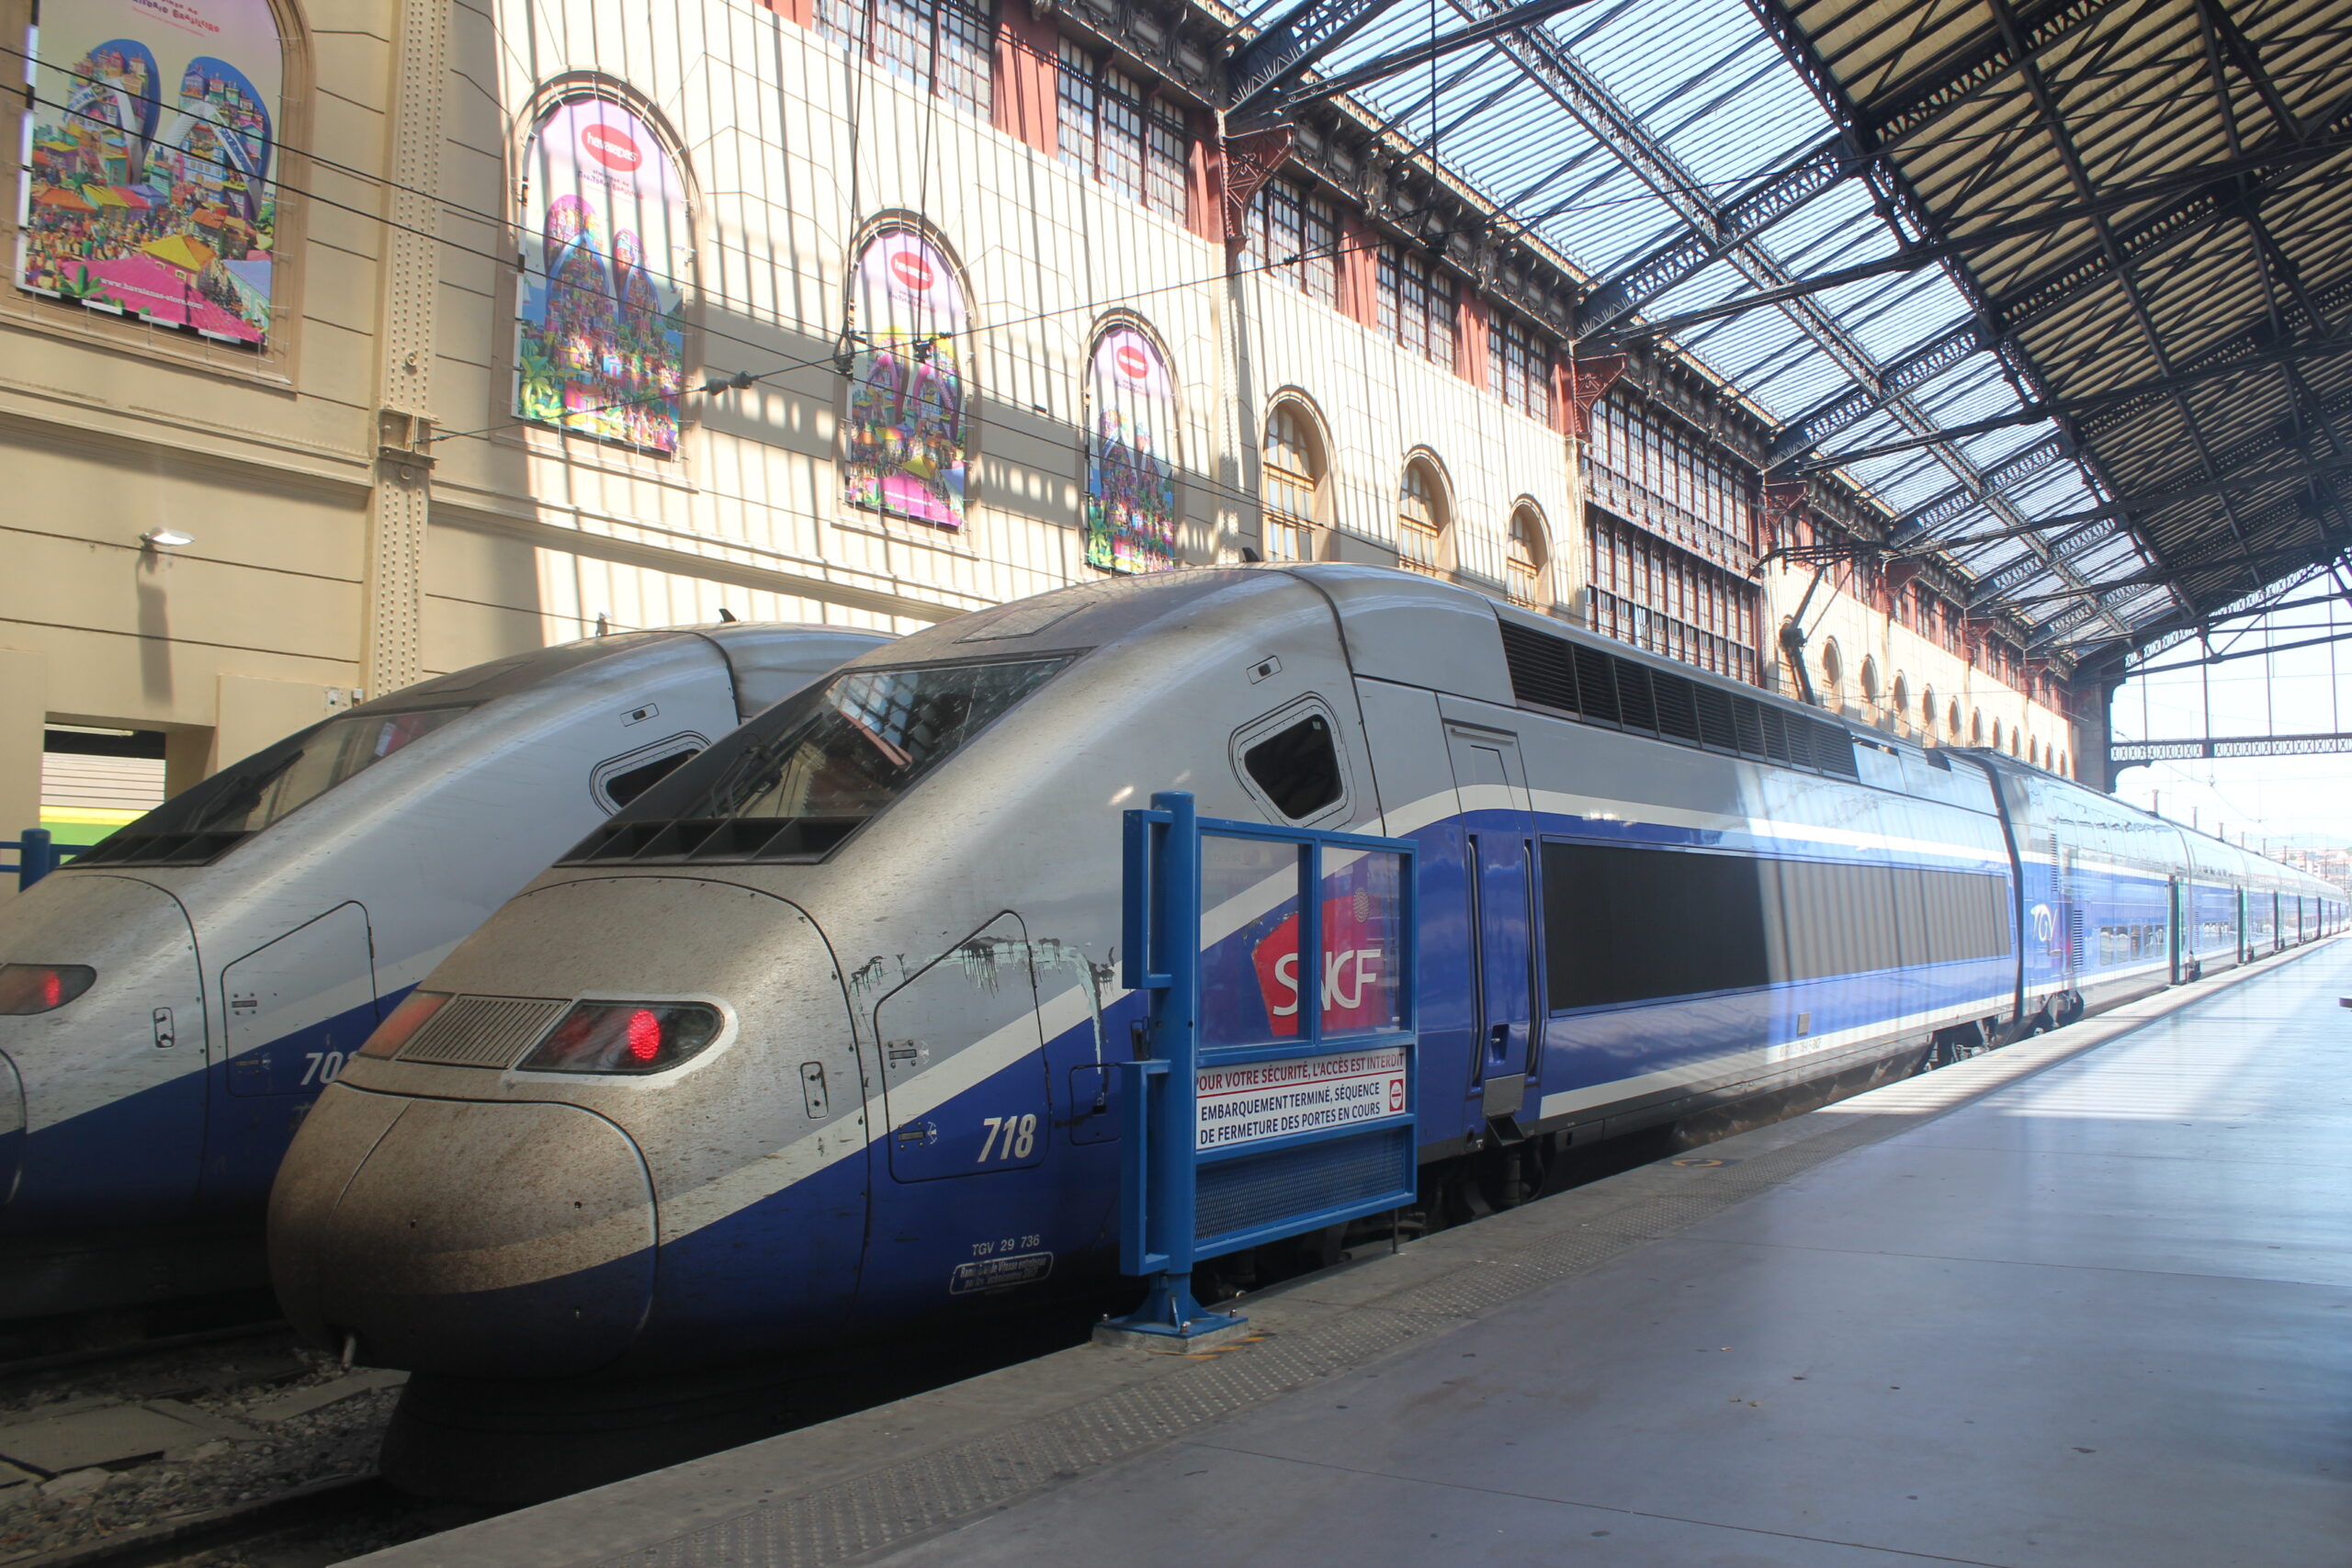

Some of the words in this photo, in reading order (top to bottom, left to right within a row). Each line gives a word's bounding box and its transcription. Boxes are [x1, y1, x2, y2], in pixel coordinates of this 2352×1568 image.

[300, 1051, 358, 1086] 70
[1197, 1073, 1223, 1092] OUR
[1226, 1070, 1259, 1089] VOTRE
[1261, 1061, 1311, 1084] SÉCURITÉ,
[1313, 1057, 1349, 1077] L'ACCÈS
[1351, 1057, 1366, 1073] EST
[1367, 1053, 1405, 1070] INTERDIT
[1201, 1095, 1288, 1122] EMBARQUEMENT
[1289, 1086, 1333, 1108] TERMINÉ,
[1334, 1082, 1380, 1101] SÉQUENCE
[977, 1113, 1037, 1163] 718
[1200, 1129, 1216, 1145] DE
[1217, 1118, 1278, 1142] FERMETURE
[1281, 1114, 1300, 1131] DES
[1302, 1109, 1336, 1128] PORTES
[1338, 1106, 1350, 1121] EN
[1351, 1101, 1381, 1119] COURS
[972, 1242, 994, 1257] TGV
[1001, 1238, 1015, 1252] 29
[1021, 1234, 1040, 1248] 736
